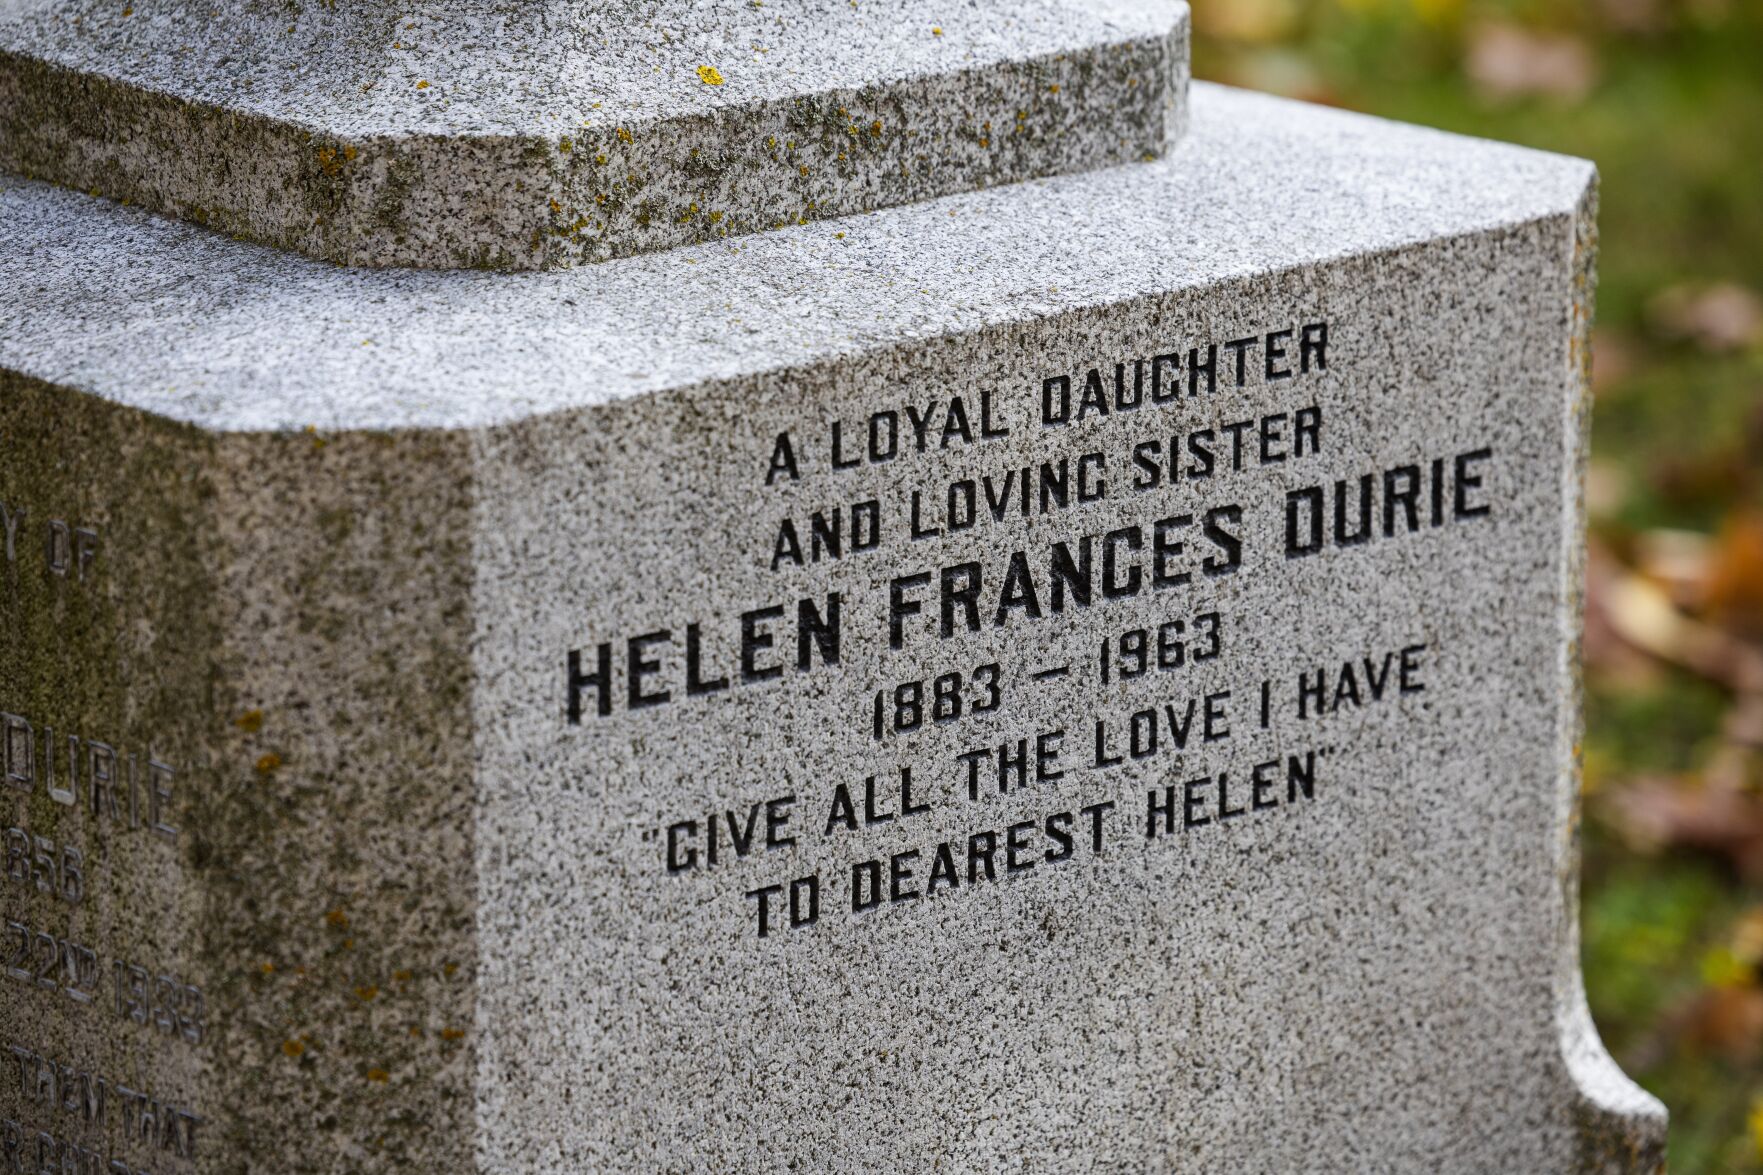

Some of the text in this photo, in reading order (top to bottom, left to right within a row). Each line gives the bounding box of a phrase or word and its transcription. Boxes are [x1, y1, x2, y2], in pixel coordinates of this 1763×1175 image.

[765, 322, 1329, 486] A LOYAL DAUGHTER
[47, 517, 99, 583] OF
[770, 406, 1322, 571] AND LOVING SISTER
[567, 447, 1492, 726] HELEN FRANCES DURIE
[824, 767, 931, 836] ALL
[957, 729, 1065, 801] THE
[1094, 689, 1231, 769] LOVE
[1260, 681, 1271, 729] I
[1299, 642, 1427, 721] HAVE
[873, 661, 1001, 740] 1883
[1100, 611, 1221, 685] 1963
[0, 711, 178, 845] DURIE
[7, 826, 83, 902] 856
[745, 874, 820, 938] TO
[852, 800, 1115, 915] DEAREST
[115, 1083, 206, 1160] THAT
